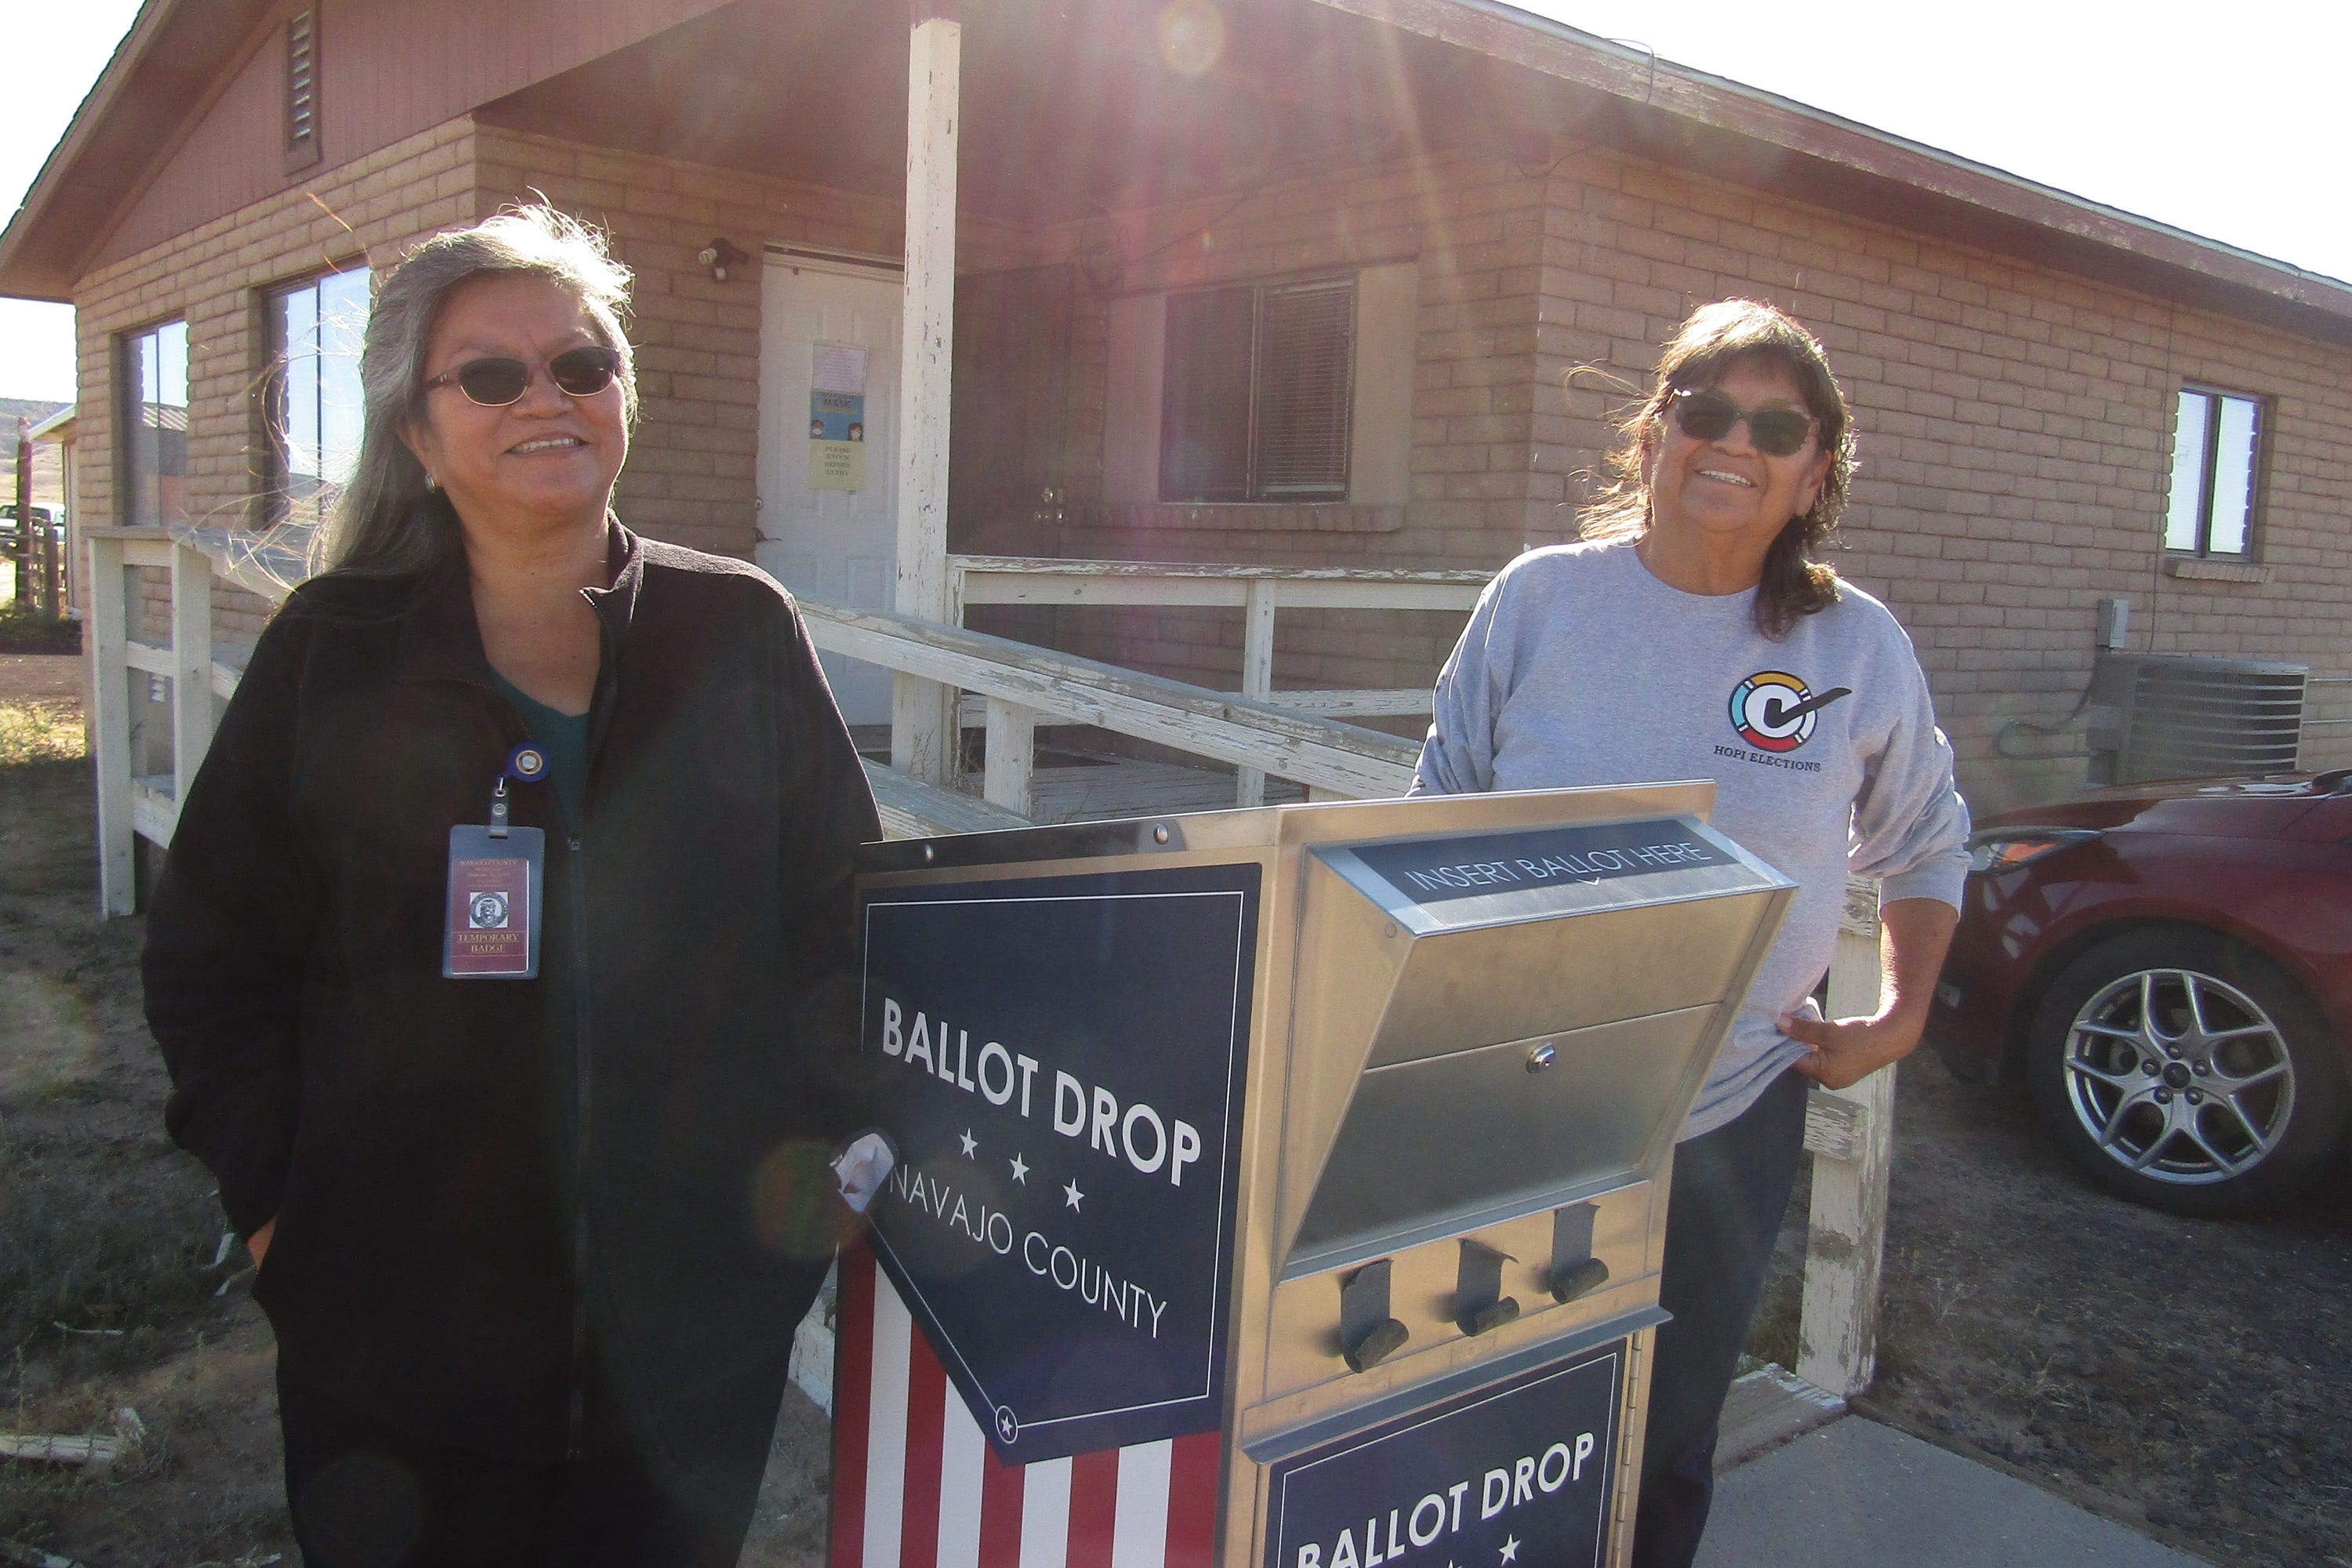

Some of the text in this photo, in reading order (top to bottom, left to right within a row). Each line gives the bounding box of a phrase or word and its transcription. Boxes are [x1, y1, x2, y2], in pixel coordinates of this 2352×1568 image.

[1713, 745, 1822, 772] HOPI ELECTIONS
[1404, 842, 1712, 891] INSERT BALLOT HERE
[459, 933, 519, 942] TEMPORARY
[471, 944, 504, 953] BADGE
[882, 997, 1201, 1187] BALLOT DROP
[888, 1163, 1167, 1339] NAVAJO COUNTY
[1481, 1432, 1594, 1520] DROP
